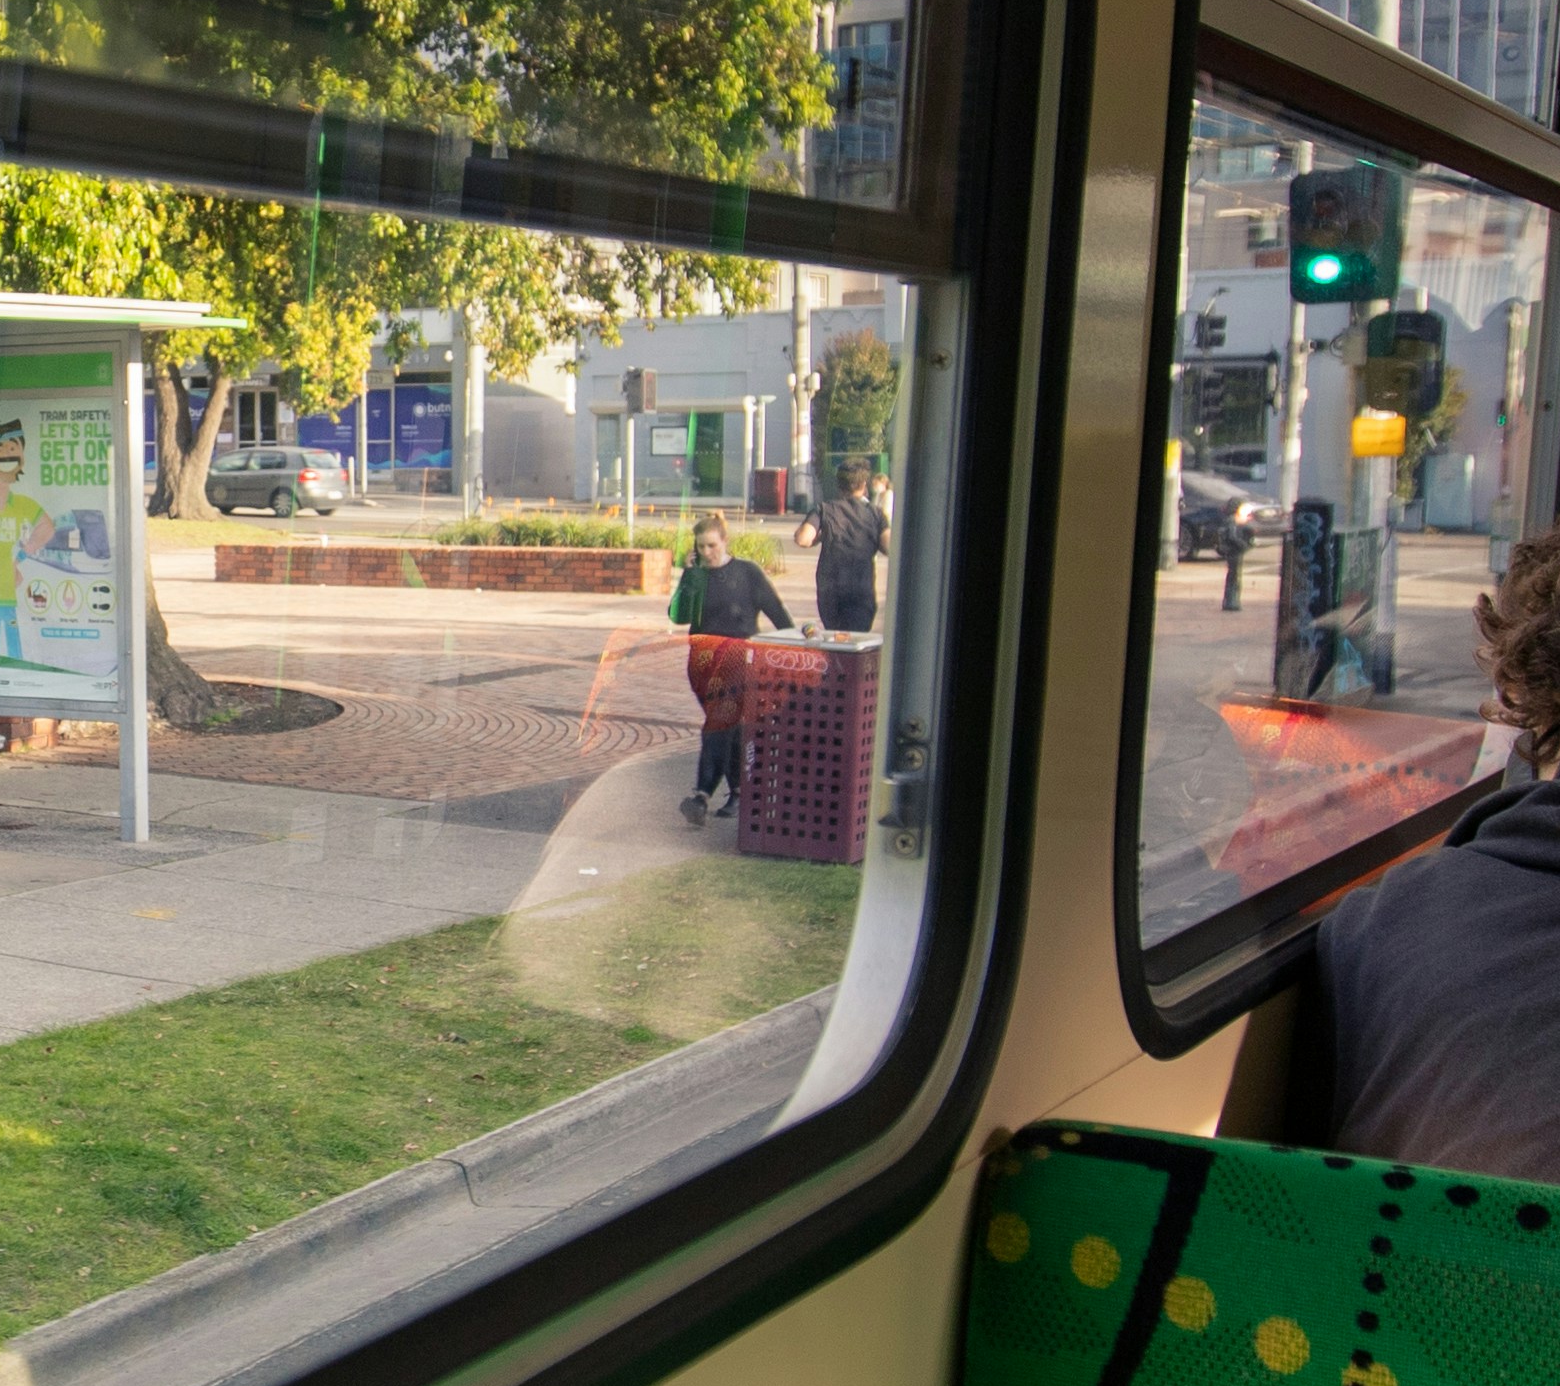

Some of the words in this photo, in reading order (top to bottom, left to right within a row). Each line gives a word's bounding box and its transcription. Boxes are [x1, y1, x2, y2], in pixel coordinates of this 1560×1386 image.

[39, 410, 68, 422] TRAM
[70, 409, 111, 421] SAFETY:
[40, 423, 80, 438] LET'S
[84, 422, 112, 438] ALL
[40, 440, 80, 462] GET
[84, 439, 112, 462] ON
[40, 463, 110, 486] BOARD
